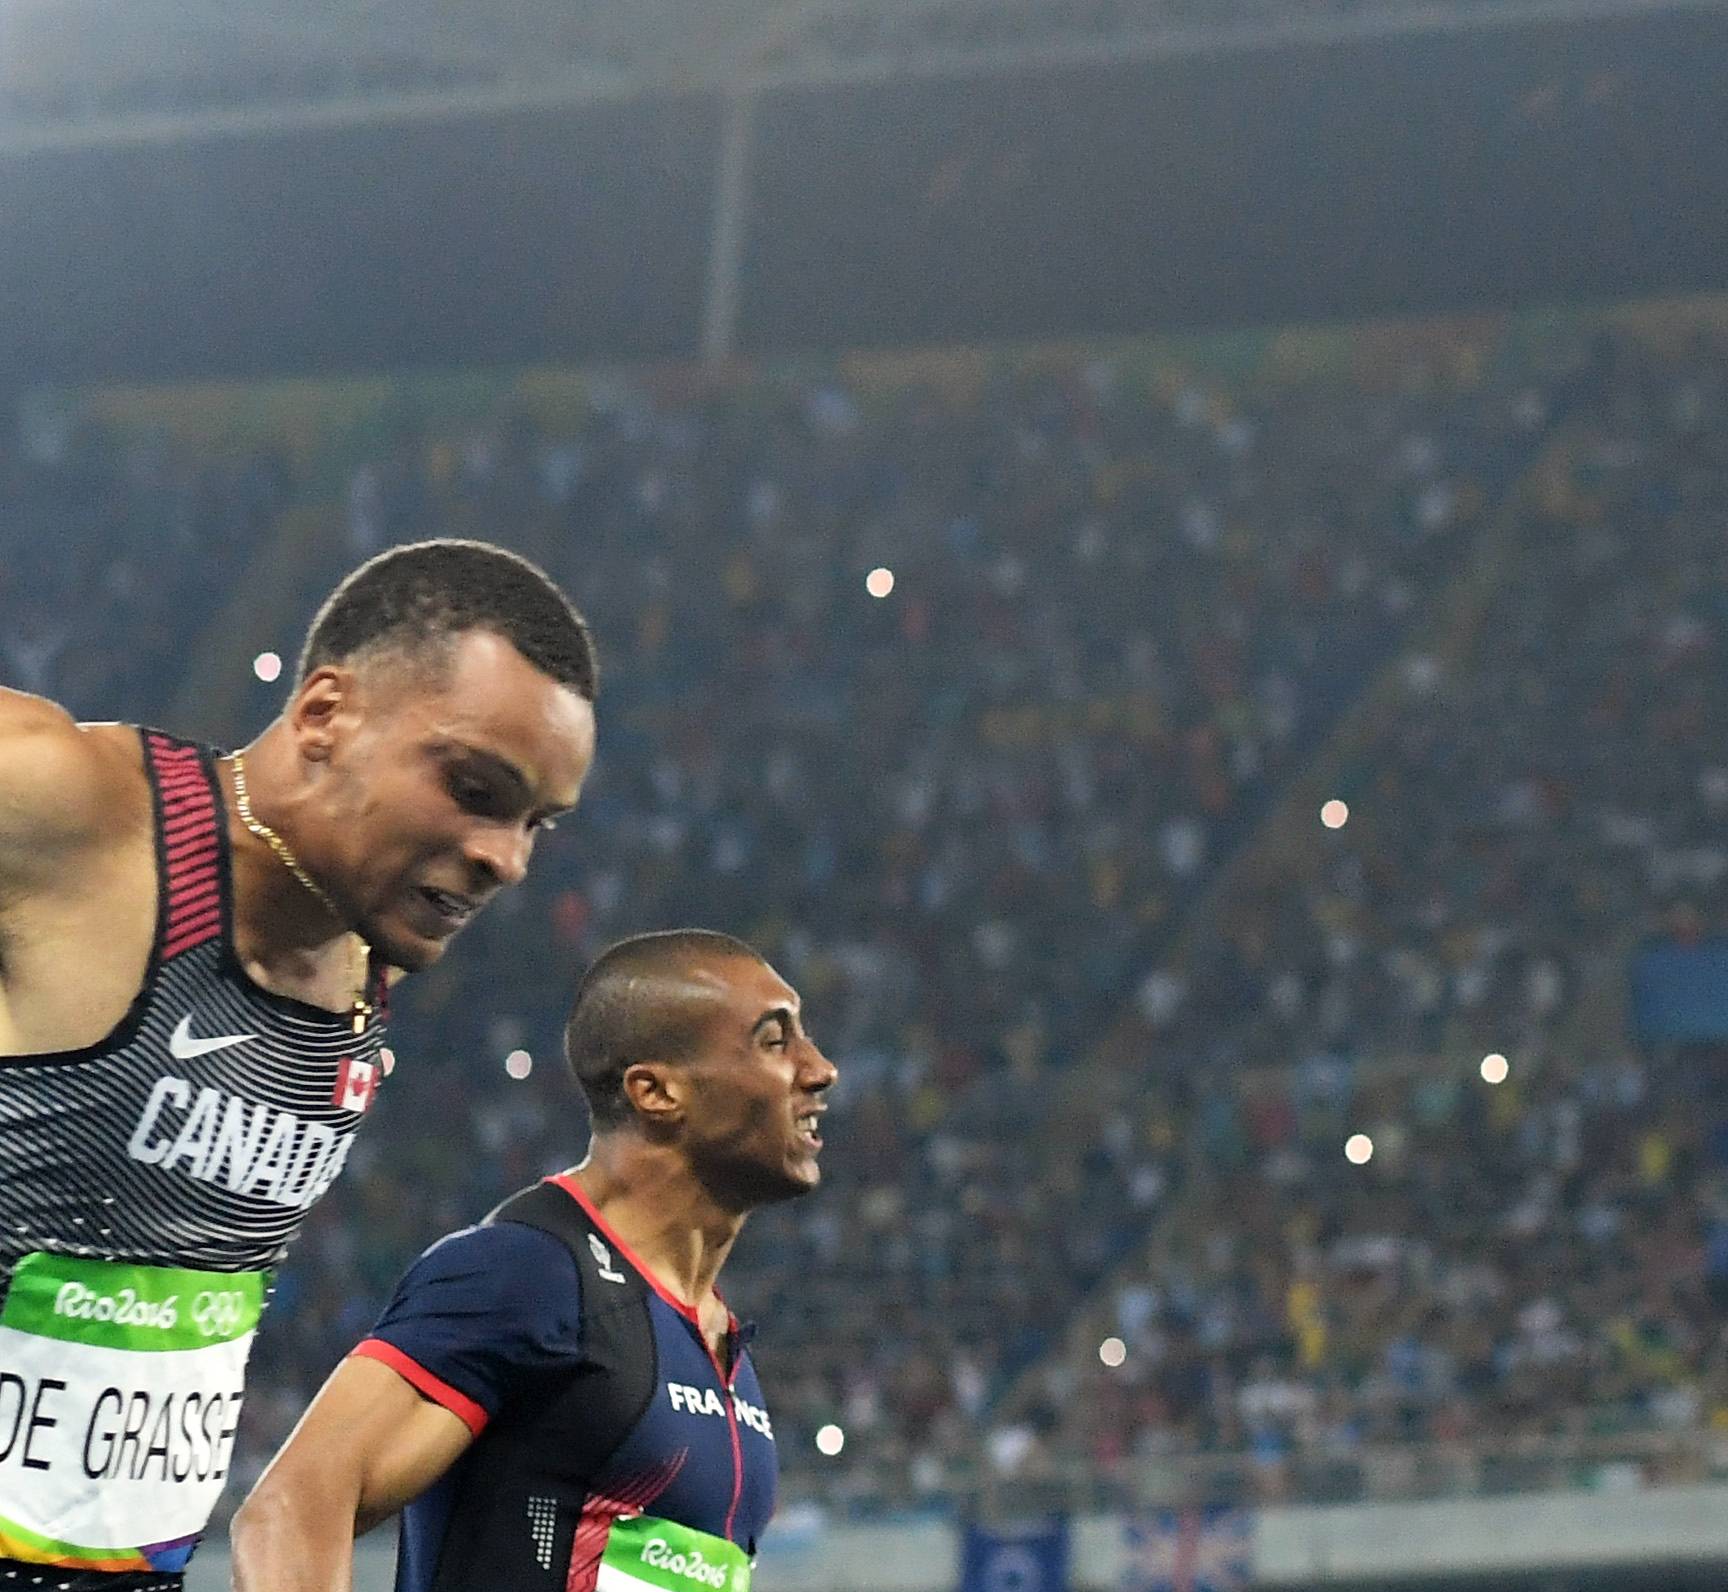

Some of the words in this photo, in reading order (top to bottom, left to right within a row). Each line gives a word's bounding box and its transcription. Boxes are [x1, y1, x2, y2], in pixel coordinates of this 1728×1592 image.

[54, 1281, 178, 1329] Rio2016
[0, 1372, 66, 1470] DE
[83, 1387, 244, 1483] GRASSE
[667, 1382, 774, 1440] FRANCE
[641, 1538, 728, 1589] Rio2016
